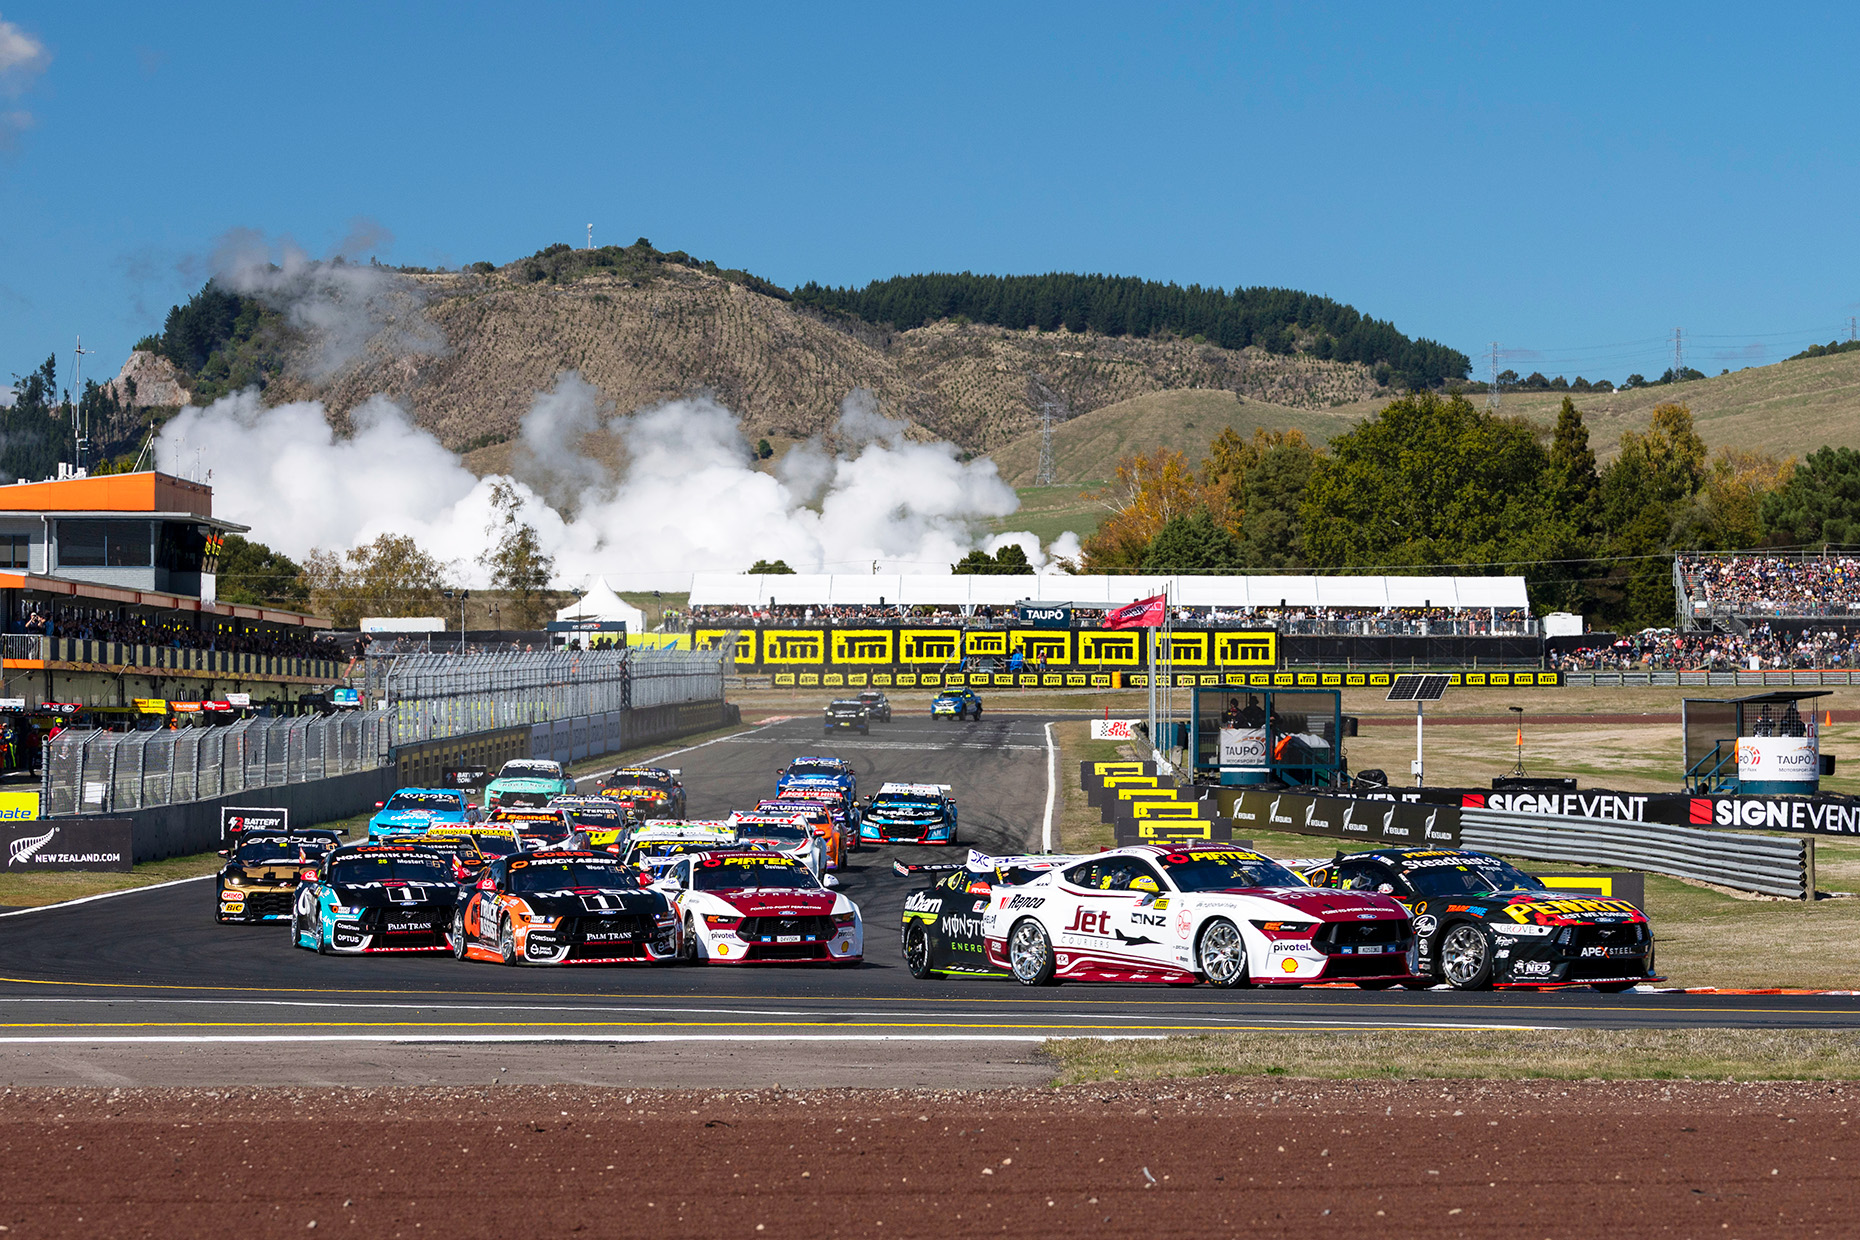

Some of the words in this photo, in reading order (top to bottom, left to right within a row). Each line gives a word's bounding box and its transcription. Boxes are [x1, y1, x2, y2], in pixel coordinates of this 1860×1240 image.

[1226, 746, 1258, 756] TAUPO
[1776, 755, 1811, 764] TAUPO
[244, 818, 280, 826] BATTERY
[724, 858, 795, 866] PIRTEK
[1188, 852, 1265, 862] PIRTEK
[1402, 857, 1489, 869] Steadfast
[346, 880, 457, 890] Mobil
[398, 887, 412, 900] 1
[534, 888, 652, 898] Mobil
[592, 895, 610, 908] 1
[1008, 894, 1046, 911] Repco
[1064, 905, 1111, 934] Jet
[1143, 914, 1166, 927] NZ
[942, 914, 985, 938] MONSTE
[1500, 924, 1535, 934] GROVE
[338, 934, 360, 943] OPTUS
[586, 933, 607, 941] PALM
[607, 932, 632, 940] TRANS
[1061, 936, 1109, 949] COURIERS
[1273, 943, 1311, 953] pivotel.
[1580, 946, 1610, 958] APEX
[1526, 964, 1550, 973] NED
